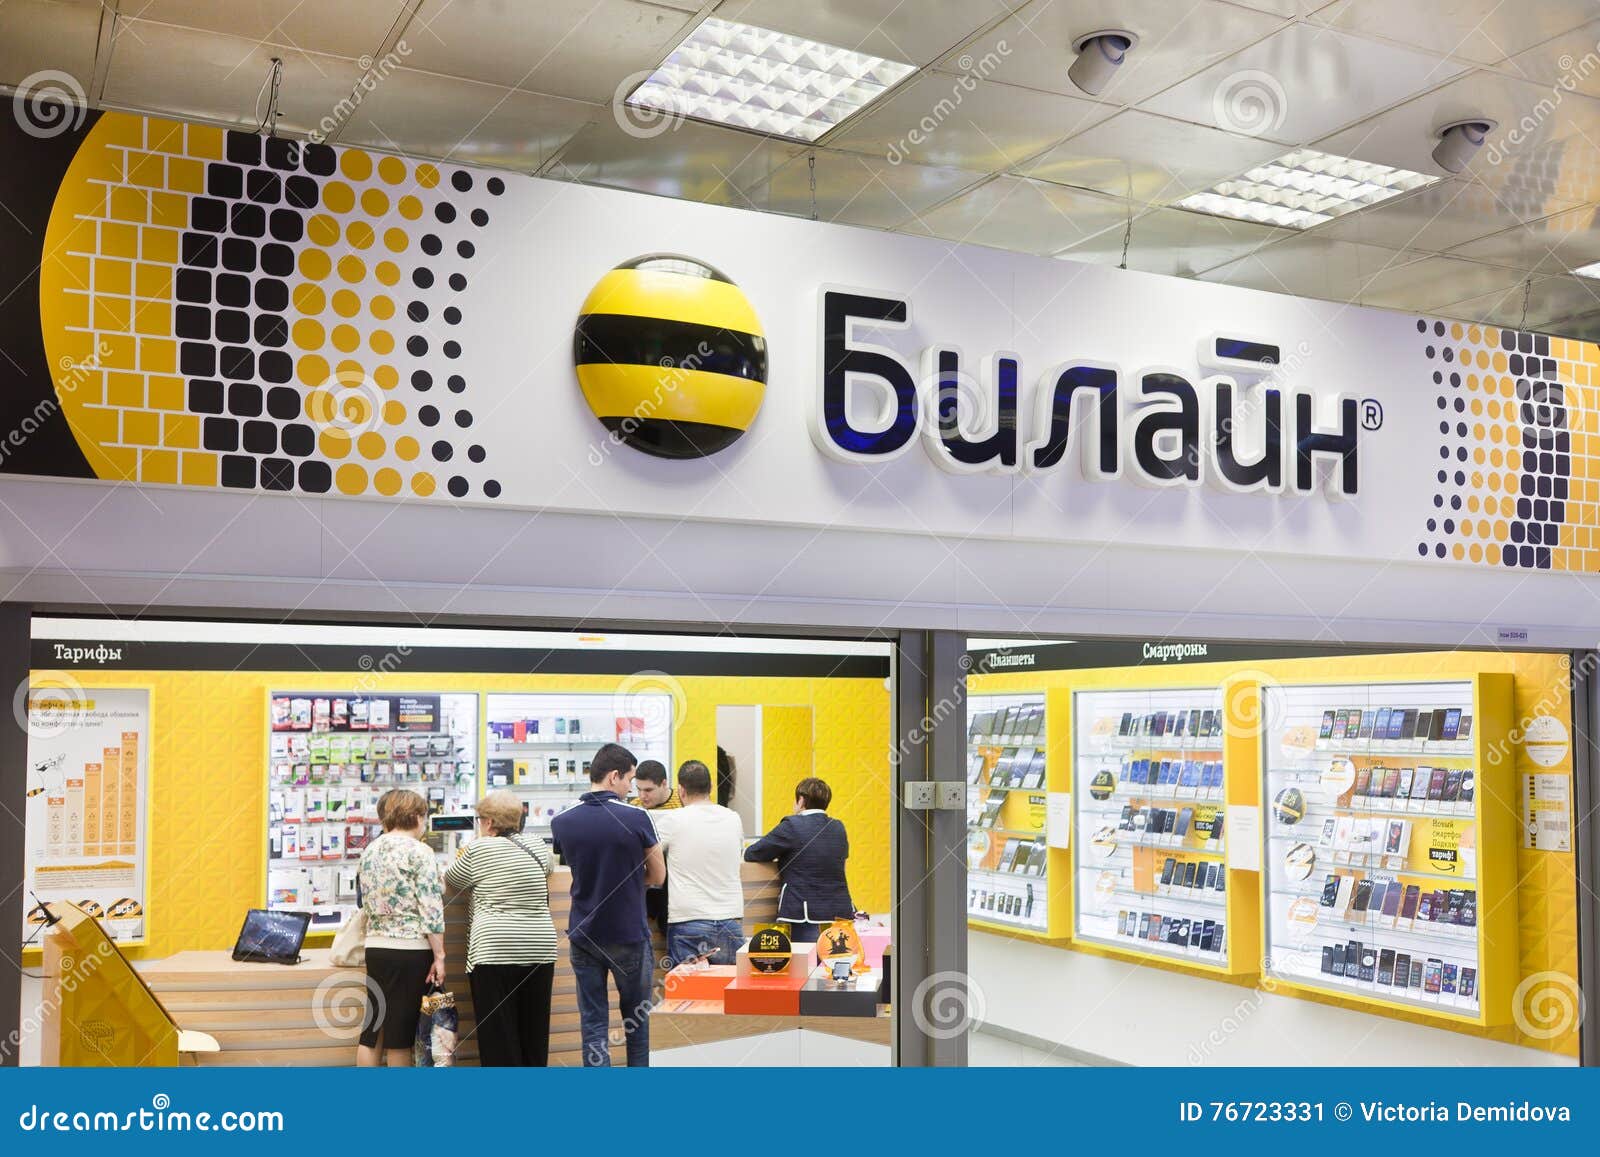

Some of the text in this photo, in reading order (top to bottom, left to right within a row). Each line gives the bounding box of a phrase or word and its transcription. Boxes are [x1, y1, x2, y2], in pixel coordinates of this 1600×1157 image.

[53, 643, 122, 664] Тарифы
[989, 653, 1035, 668] Планшеты
[1142, 643, 1208, 661] Смартфоны
